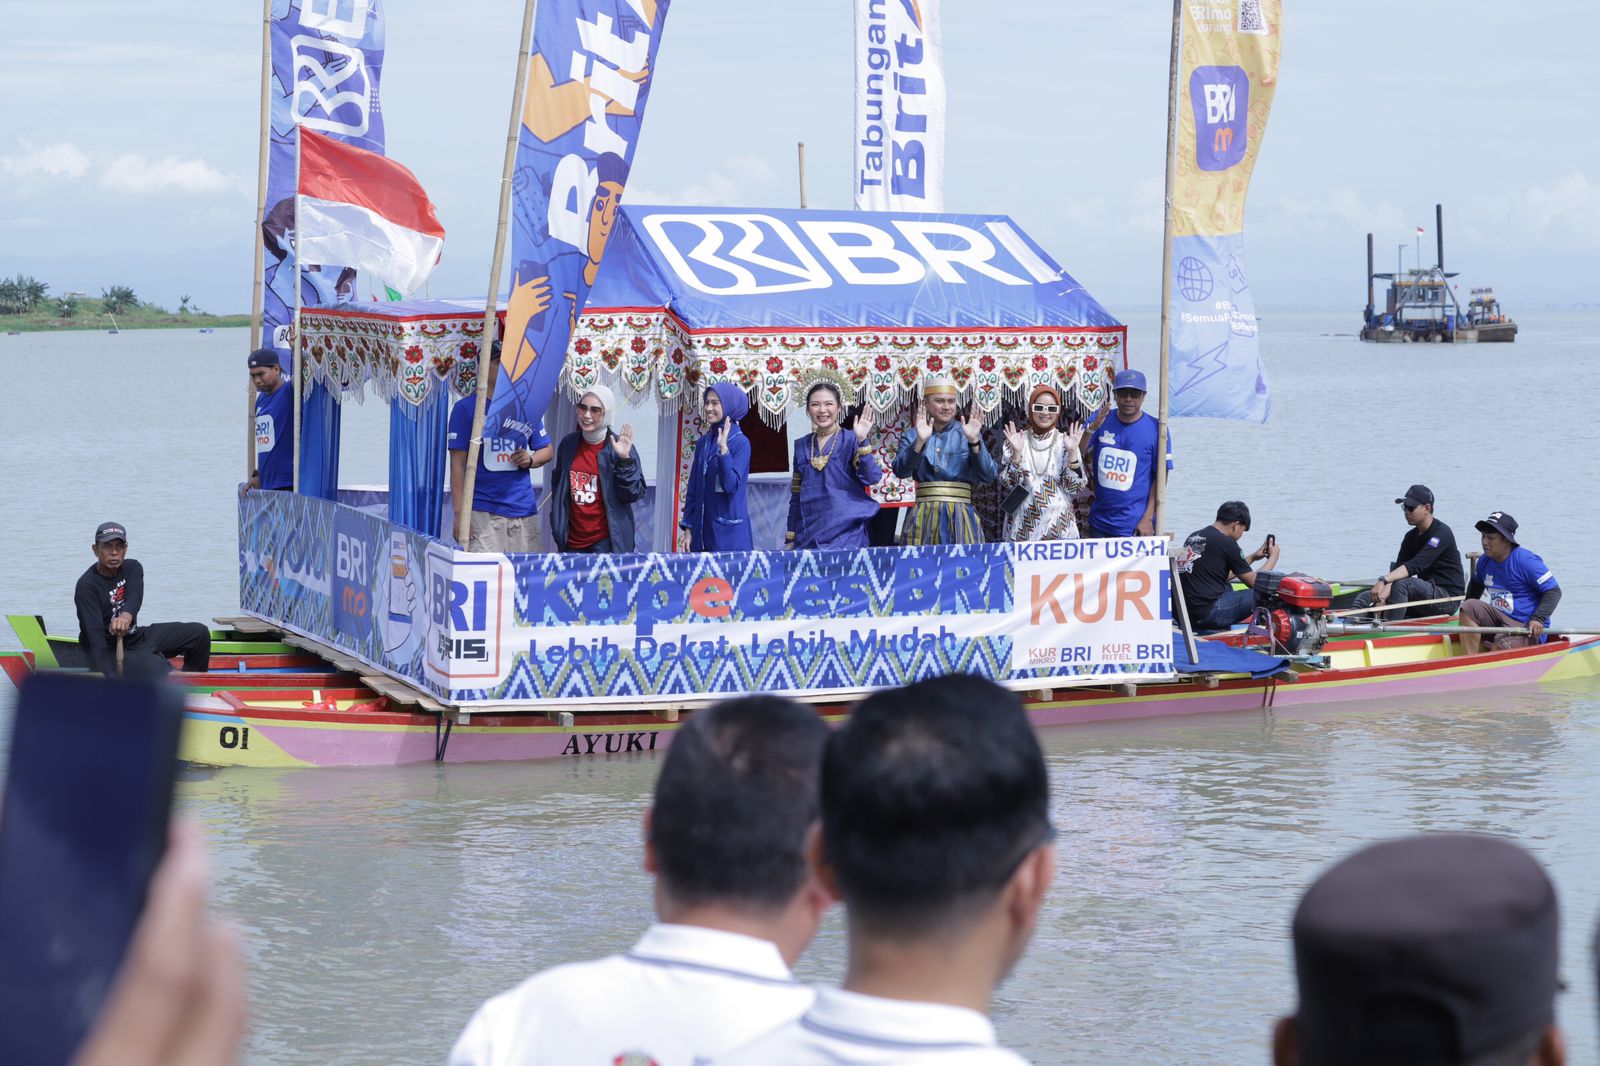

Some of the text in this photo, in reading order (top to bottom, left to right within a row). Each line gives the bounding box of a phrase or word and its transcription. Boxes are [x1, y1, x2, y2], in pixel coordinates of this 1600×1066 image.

[860, 0, 891, 194] Tabungan
[891, 0, 928, 199] Brit
[1203, 83, 1236, 124] BRI
[548, 0, 656, 256] Brit
[797, 219, 1063, 285] BRI
[1104, 454, 1130, 473] BRI
[1106, 471, 1127, 483] mo
[336, 532, 367, 587] BRI
[1017, 539, 1170, 561] KREDIT USAH
[342, 584, 367, 618] mo
[432, 571, 488, 632] BRI
[527, 551, 1005, 637] Kupedes BRI
[1030, 569, 1155, 626] KUR
[529, 625, 956, 666] Lebih Dekat Lebih Mudah
[1028, 647, 1057, 658] KUR
[1029, 656, 1057, 665] MIKRO
[1060, 646, 1092, 662] BRI
[1101, 643, 1132, 654] KUR
[1101, 653, 1132, 661] RITEL
[1136, 643, 1170, 660] BRI
[560, 731, 659, 755] AYUKI
